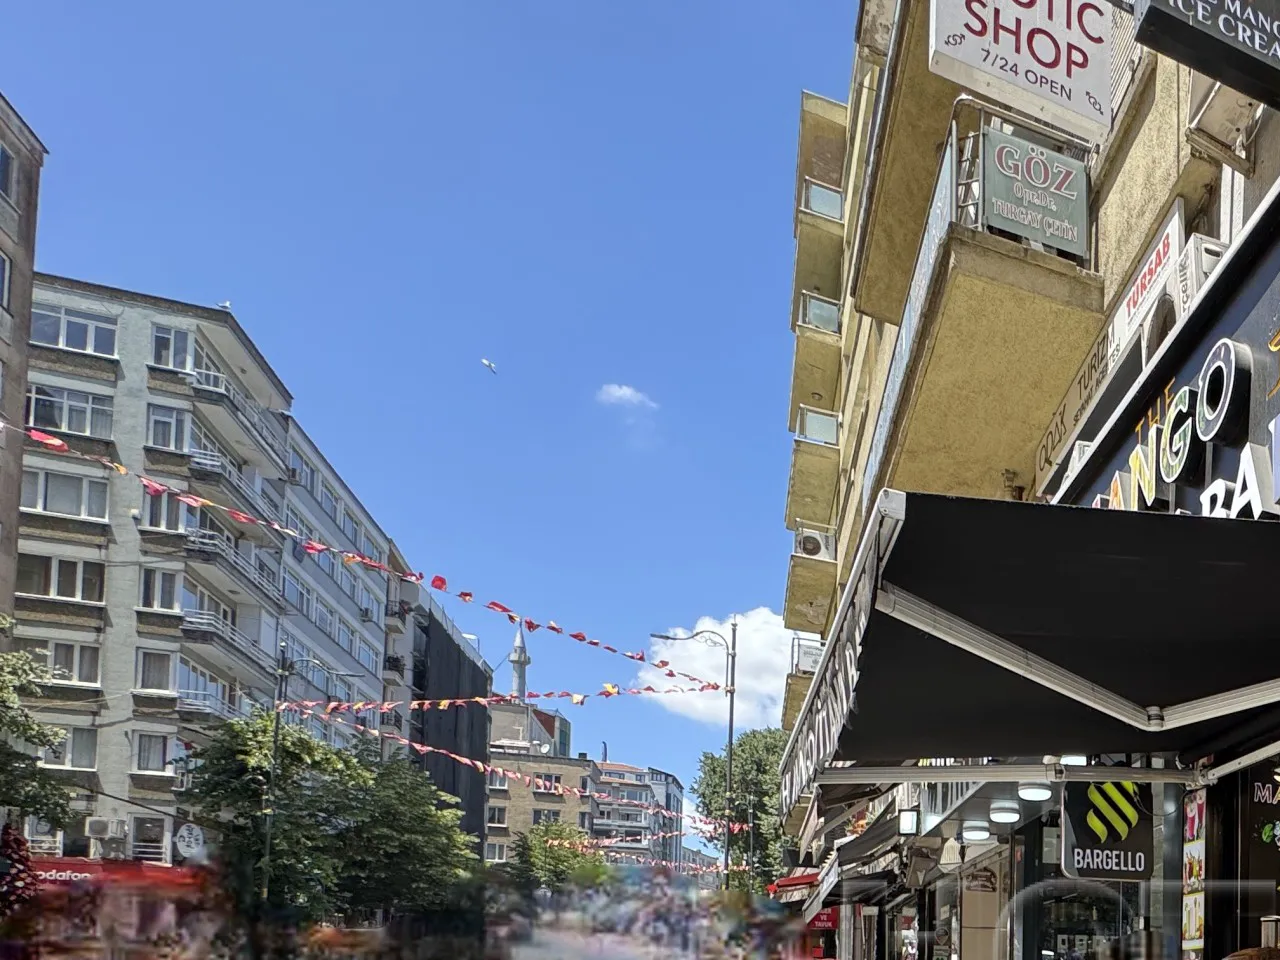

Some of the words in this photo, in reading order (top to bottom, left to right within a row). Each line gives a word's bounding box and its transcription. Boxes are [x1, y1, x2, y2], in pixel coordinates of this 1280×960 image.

[963, 0, 1089, 79] SHOP
[981, 48, 1019, 77] 7/24
[1024, 69, 1072, 101] OPEN
[994, 143, 1078, 201] GÖZ
[991, 197, 1042, 229] TURGAY
[1091, 337, 1237, 511] ANGO
[1135, 377, 1176, 442] THE
[35, 869, 92, 881] odafon
[1073, 847, 1146, 873] BARGELLO
